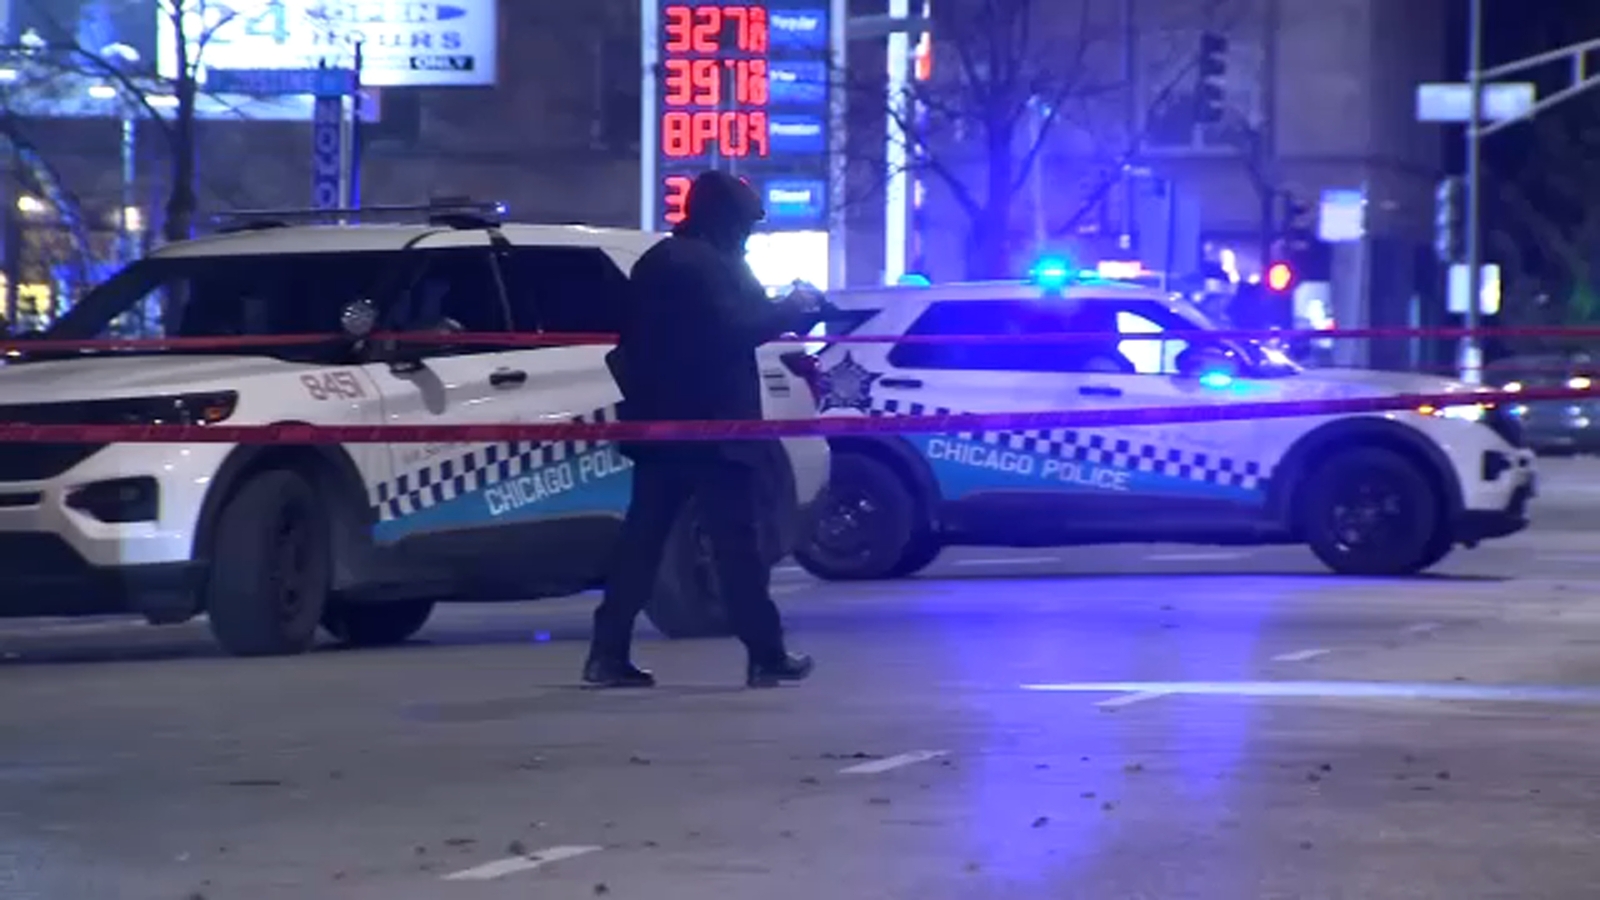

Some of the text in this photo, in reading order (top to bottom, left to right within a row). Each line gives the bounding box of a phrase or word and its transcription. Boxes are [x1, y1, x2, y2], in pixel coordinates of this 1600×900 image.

[300, 369, 367, 401] 8451
[484, 462, 574, 516] CHICAGO
[928, 439, 1132, 491] CHICAGO POLICE
